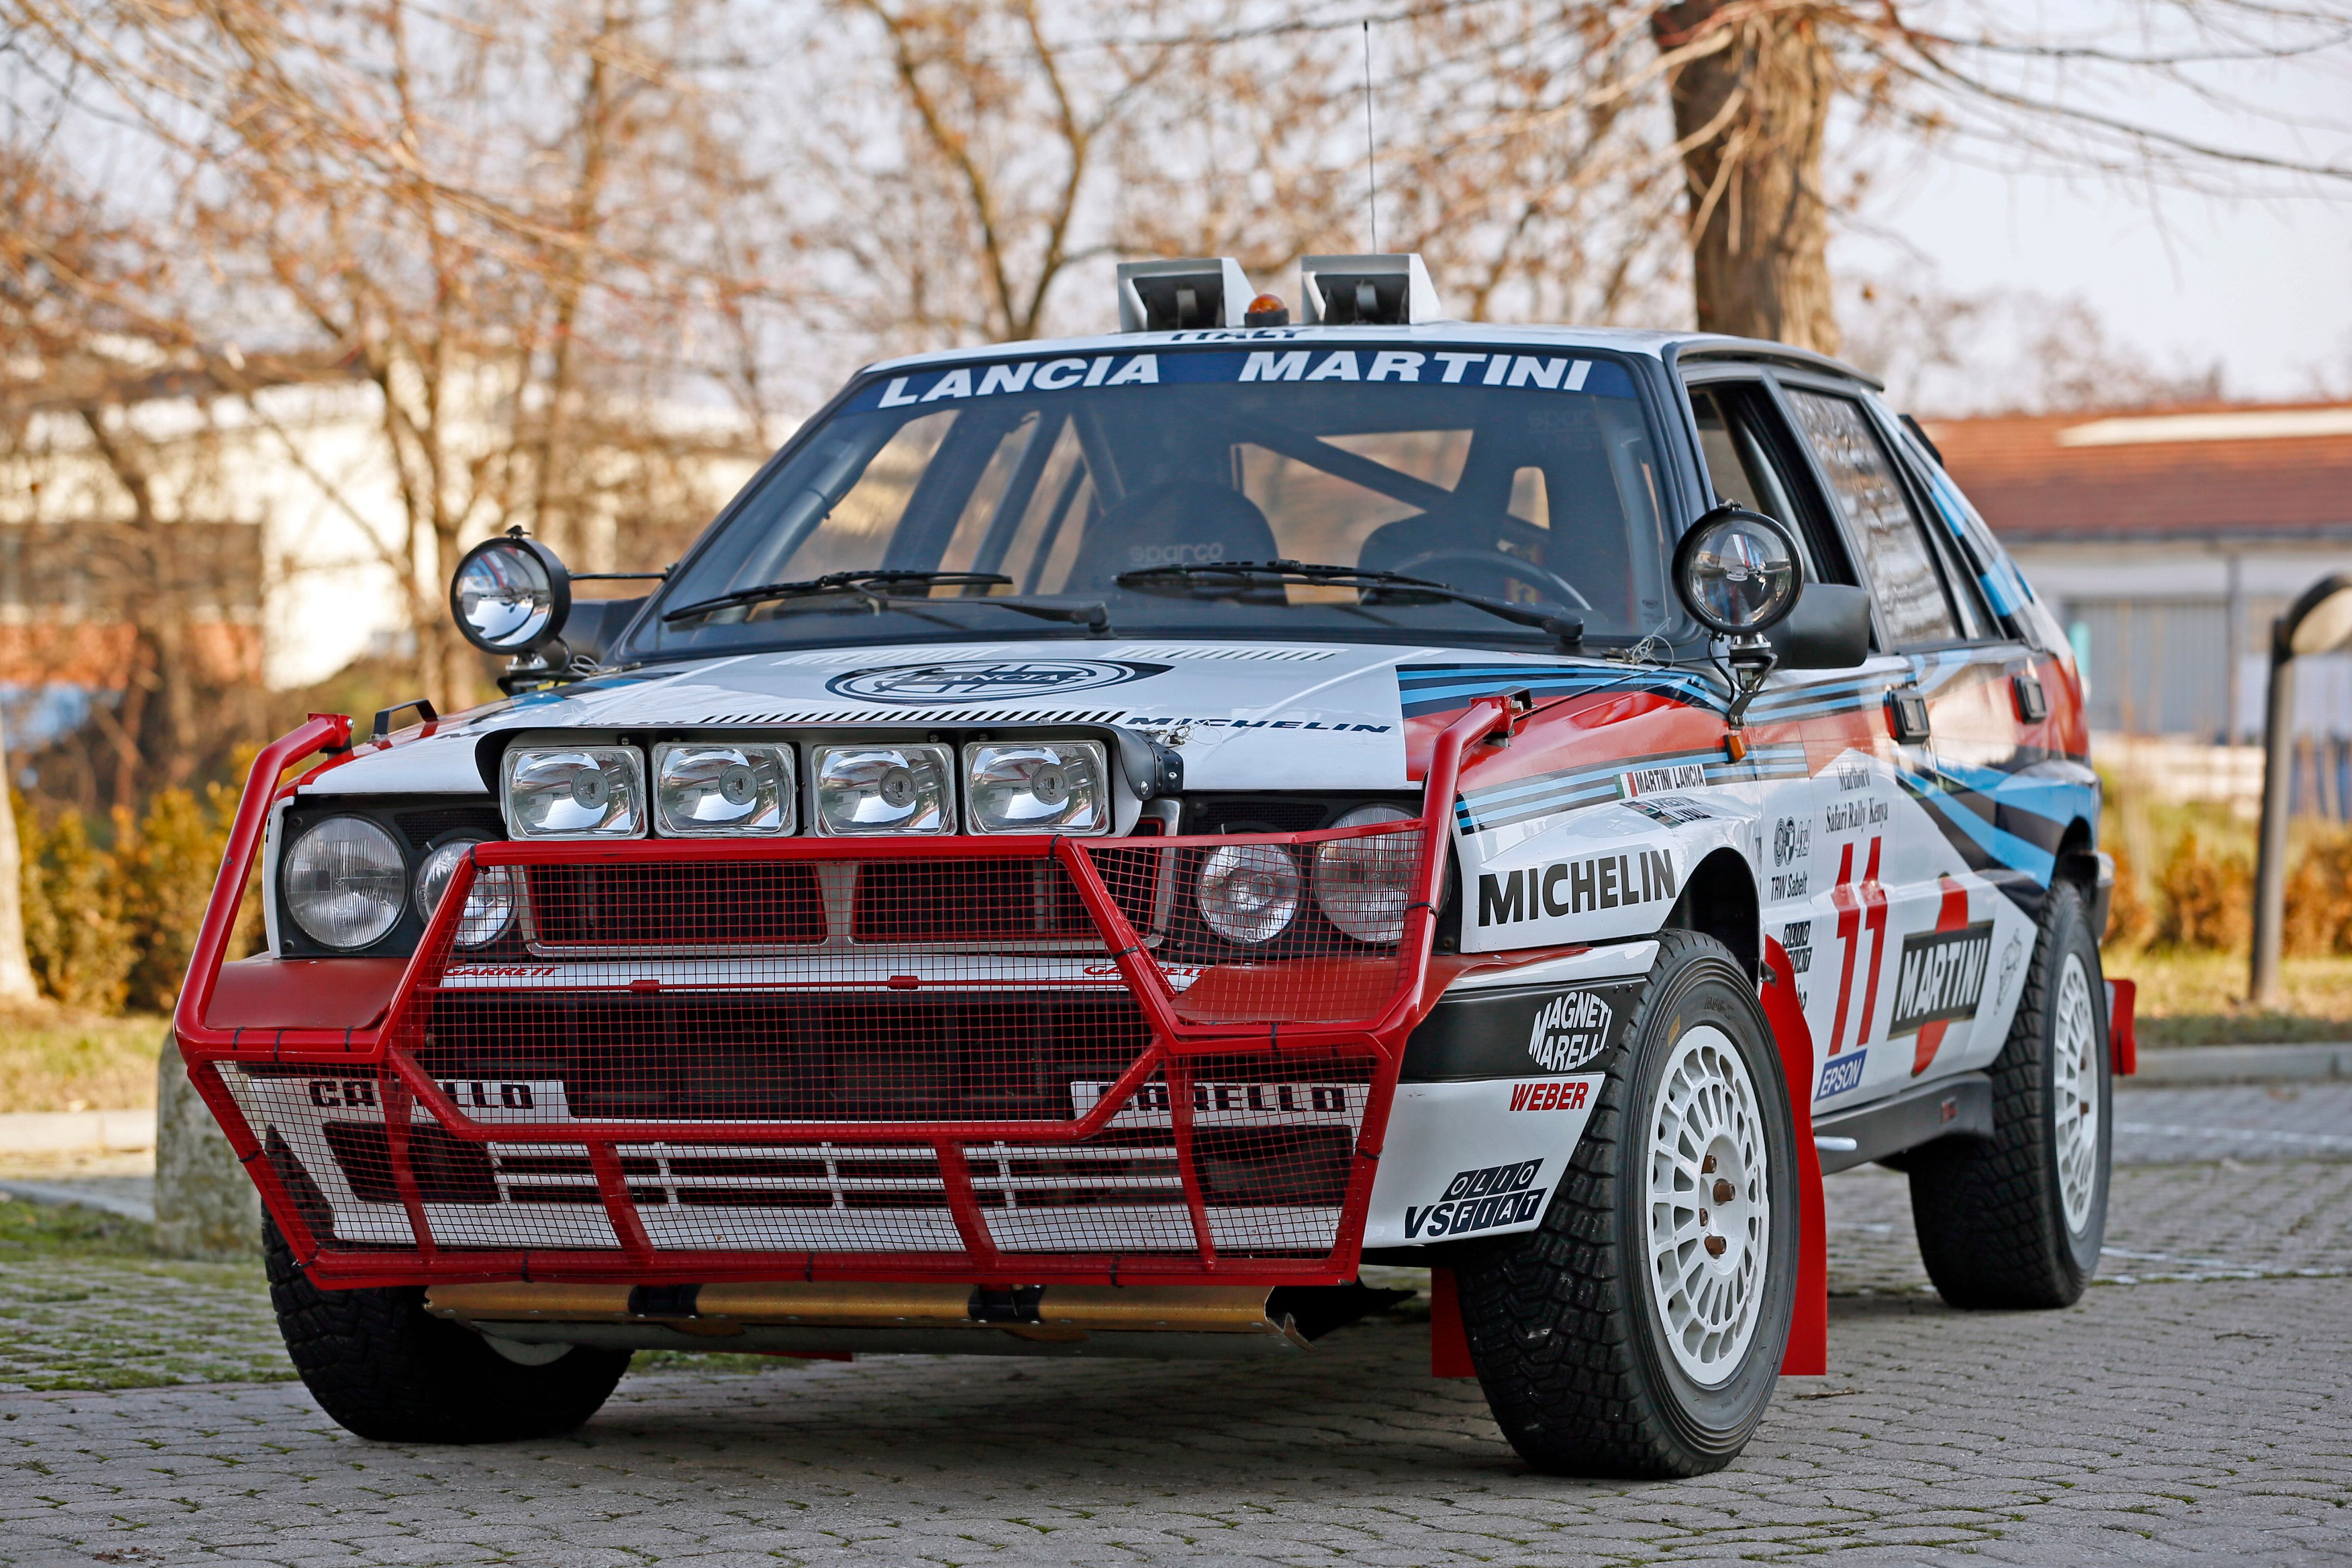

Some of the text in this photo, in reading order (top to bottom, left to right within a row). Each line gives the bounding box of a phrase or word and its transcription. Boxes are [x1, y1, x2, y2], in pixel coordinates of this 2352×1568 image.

[878, 350, 1592, 409] LANCIA MARTINI
[916, 673, 1061, 682] LANCIA
[1125, 716, 1393, 733] MICHELIN
[1635, 765, 1705, 794] MARTINI LANCIA
[1826, 797, 1888, 833] Safari Rally Kenya
[1795, 819, 1811, 858] 4x4
[1478, 848, 1676, 927] MICHELIN
[1771, 871, 1808, 902] TRW Sabelt
[1784, 924, 1809, 945] OLIO
[1828, 835, 1888, 1057] 11
[444, 967, 561, 976] GARRETT
[1896, 937, 1989, 1022] MARTINI
[1529, 991, 1613, 1034] MAGNETI
[1528, 1031, 1607, 1071] MARELLI
[1819, 1057, 1862, 1097] EPSON
[1509, 1082, 1589, 1112] WEBER
[1450, 1164, 1535, 1196] OLIO
